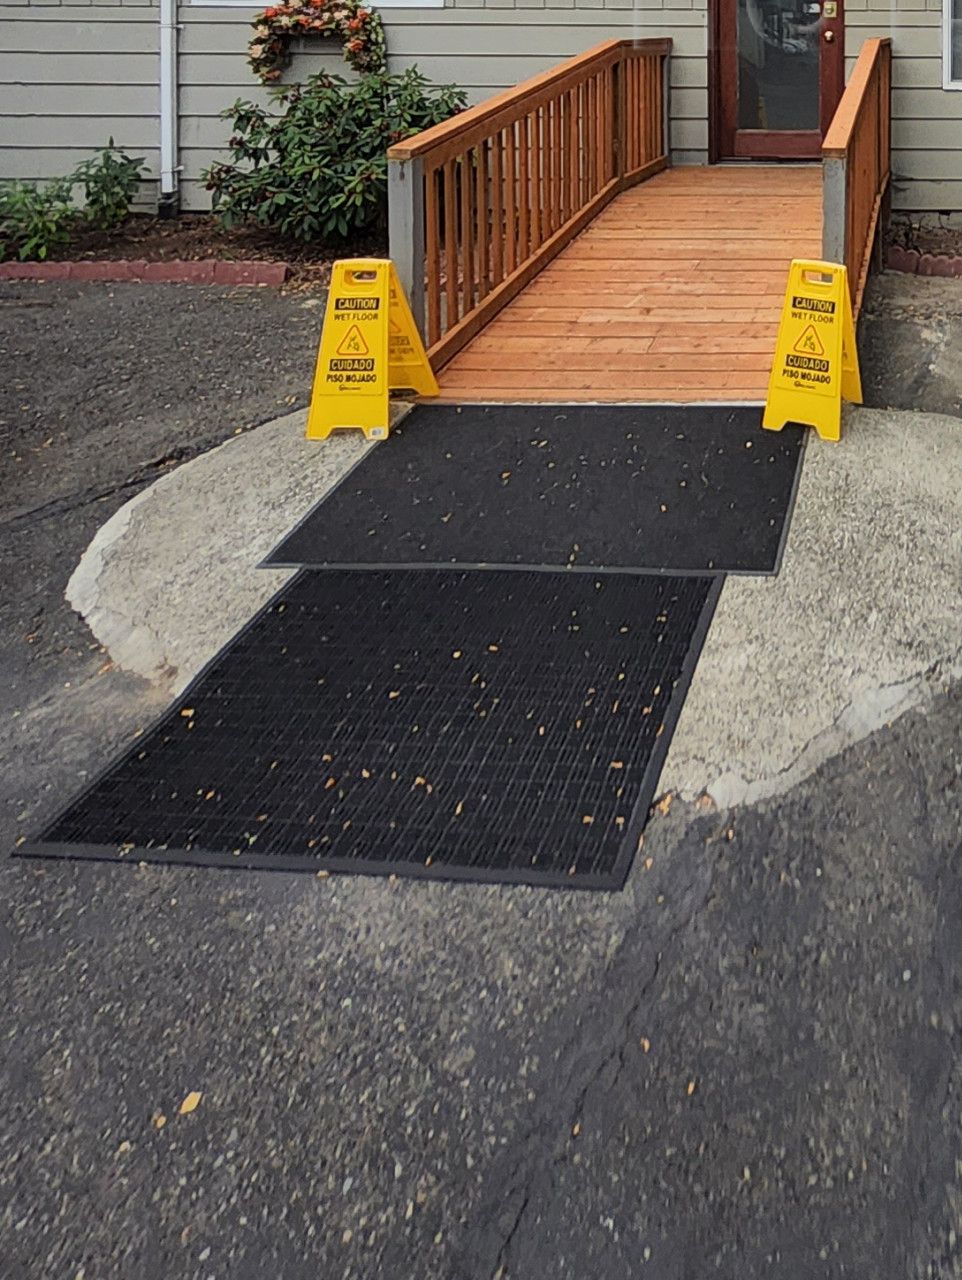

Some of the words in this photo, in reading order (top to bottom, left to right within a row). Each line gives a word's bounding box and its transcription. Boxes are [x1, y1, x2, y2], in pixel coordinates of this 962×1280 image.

[338, 299, 377, 309] CAUTION
[795, 297, 833, 312] CAUTION
[353, 313, 379, 321] FLOOR
[791, 312, 807, 320] WET
[809, 313, 834, 323] FLOOR
[331, 360, 373, 370] CUIDADO
[788, 356, 828, 371] CUIDADO
[326, 374, 344, 383] PISO
[345, 373, 377, 383] MOJADO
[782, 369, 800, 379] PISO
[801, 372, 832, 384] MOJADO
